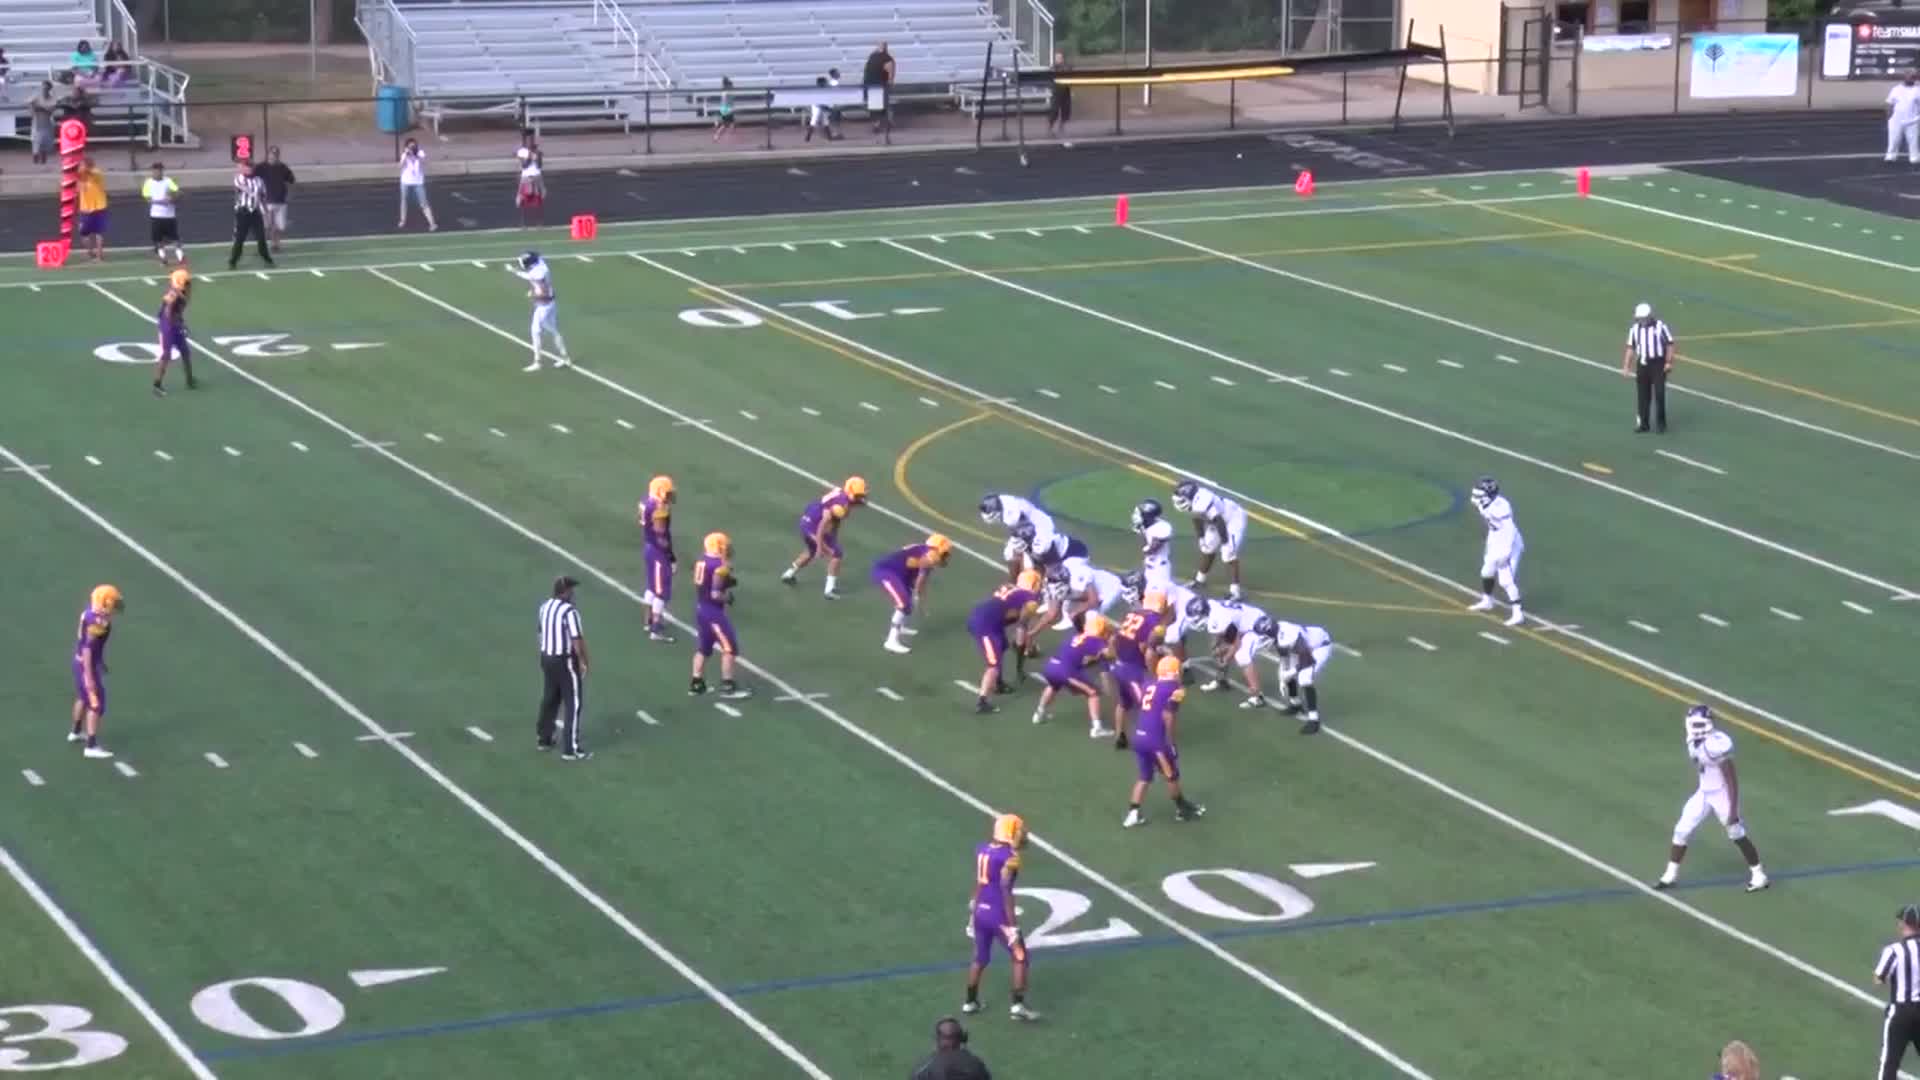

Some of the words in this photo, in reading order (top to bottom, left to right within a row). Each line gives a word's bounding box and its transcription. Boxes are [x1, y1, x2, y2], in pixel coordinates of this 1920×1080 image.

[41, 246, 60, 263] 20
[678, 301, 887, 327] 10
[93, 333, 311, 362] 20
[1120, 613, 1144, 640] 22
[1142, 685, 1156, 710] 2
[977, 853, 990, 884] 11
[1012, 869, 1315, 949] 20
[0, 977, 346, 1071] 30
